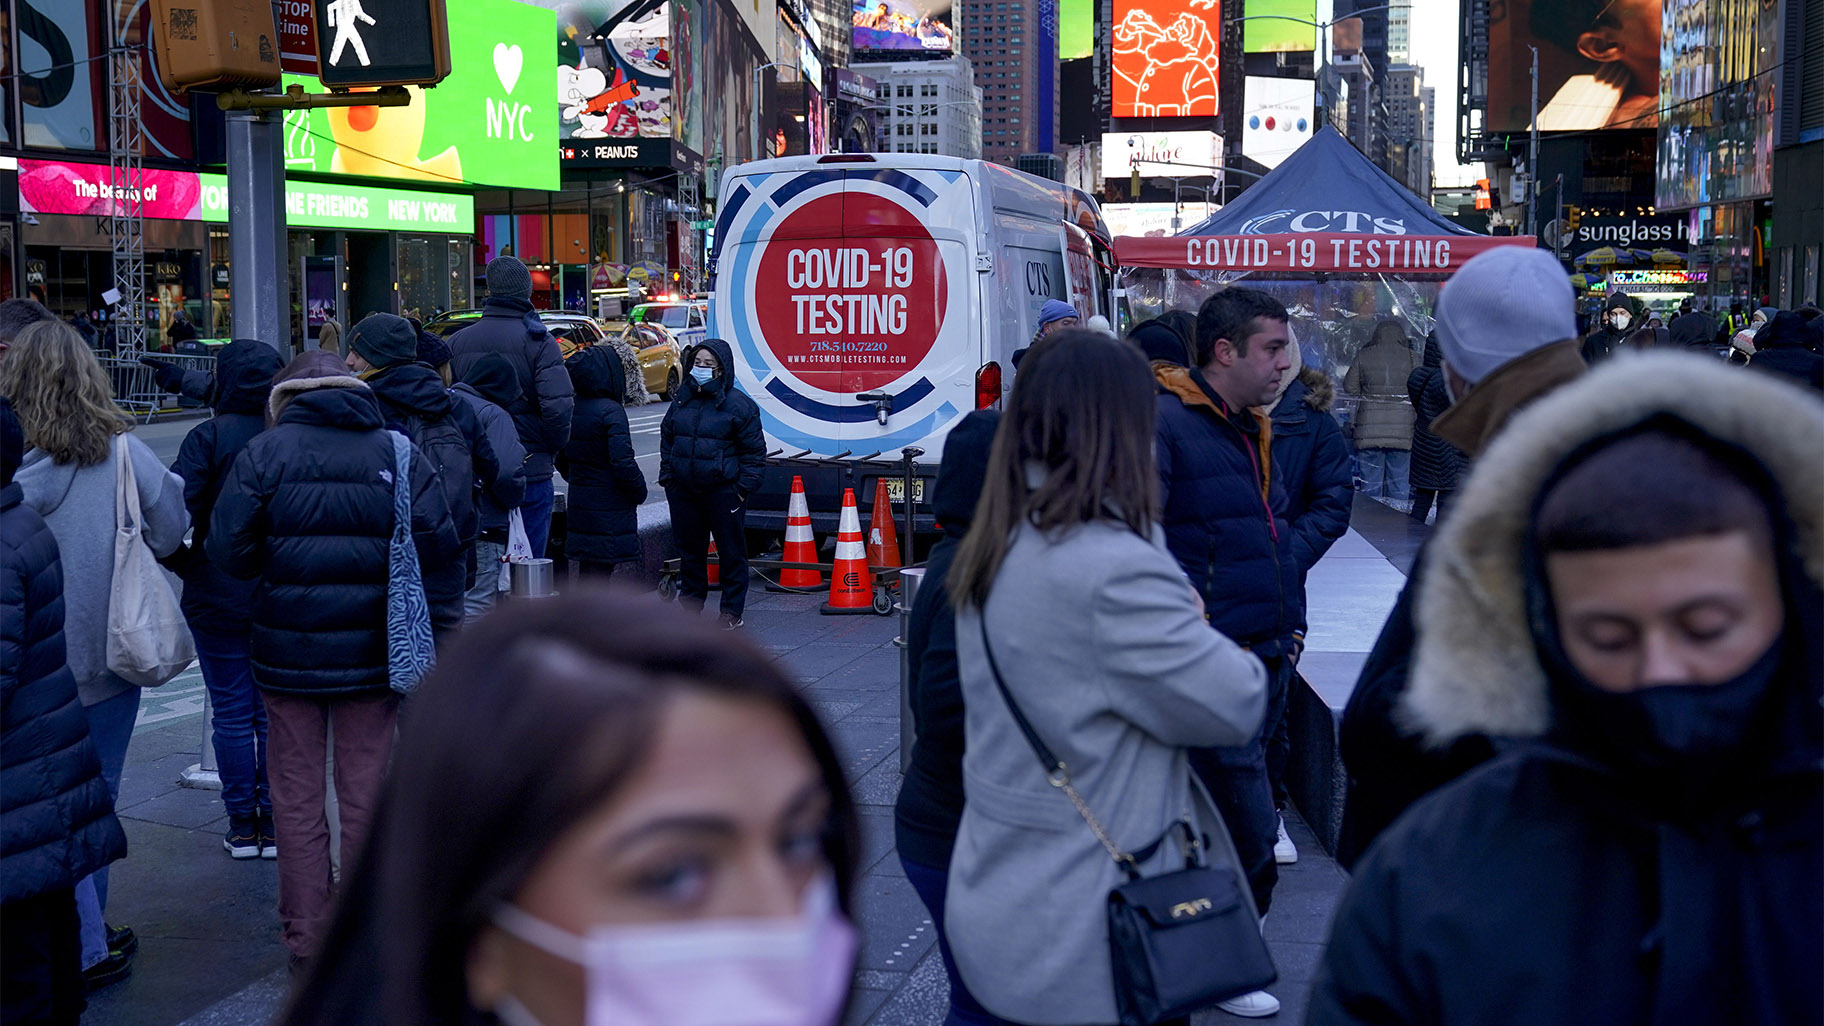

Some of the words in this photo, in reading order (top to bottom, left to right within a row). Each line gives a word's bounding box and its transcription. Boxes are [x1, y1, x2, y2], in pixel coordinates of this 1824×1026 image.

[486, 97, 534, 142] NYC
[595, 145, 639, 159] PEANUTS
[73, 179, 98, 198] The
[144, 184, 157, 201] of
[307, 193, 369, 219] FRIENDS
[388, 199, 420, 221] NEW
[423, 201, 458, 224] YORK
[1290, 210, 1407, 236] CTS
[1579, 219, 1672, 247] sunglass
[787, 247, 914, 289] COVID-19
[1187, 238, 1317, 268] COVID-19
[1330, 238, 1451, 269] TESTING
[1026, 260, 1051, 297] CTS
[791, 293, 907, 335] TESTING
